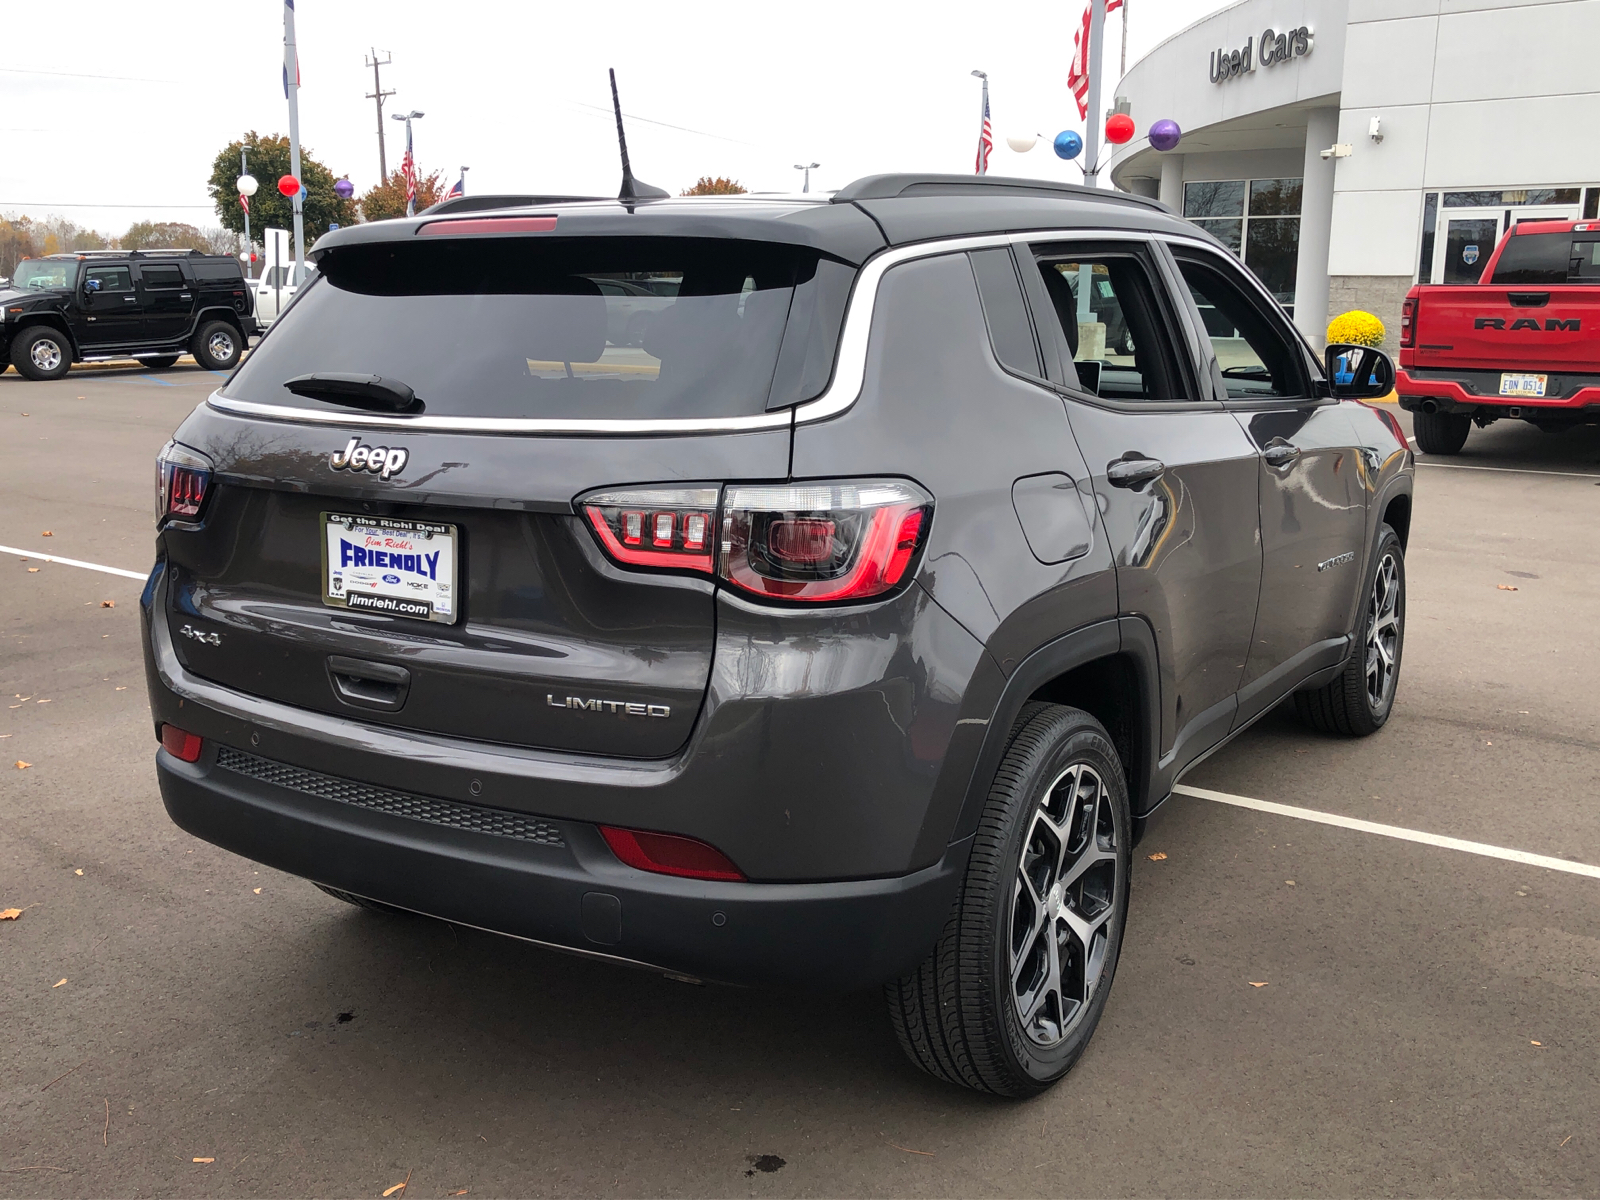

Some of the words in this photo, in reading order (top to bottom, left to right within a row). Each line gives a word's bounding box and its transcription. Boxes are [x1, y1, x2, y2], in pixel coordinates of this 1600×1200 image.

[1209, 36, 1256, 84] Used
[1259, 26, 1312, 67] Cars
[1474, 318, 1581, 332] RAM
[331, 436, 409, 480] Jeep
[330, 514, 353, 523] Get
[356, 517, 377, 526] the
[380, 520, 412, 530] Riehl
[416, 523, 445, 533] Deal
[365, 526, 379, 536] Your
[364, 536, 382, 548] Jim
[384, 538, 413, 550] Riehl's
[340, 537, 440, 581] FRIENDLY
[406, 581, 429, 590] MOKE
[348, 593, 428, 615] jimriehl.com
[179, 624, 221, 647] 4x4
[546, 694, 671, 718] LIMITED
